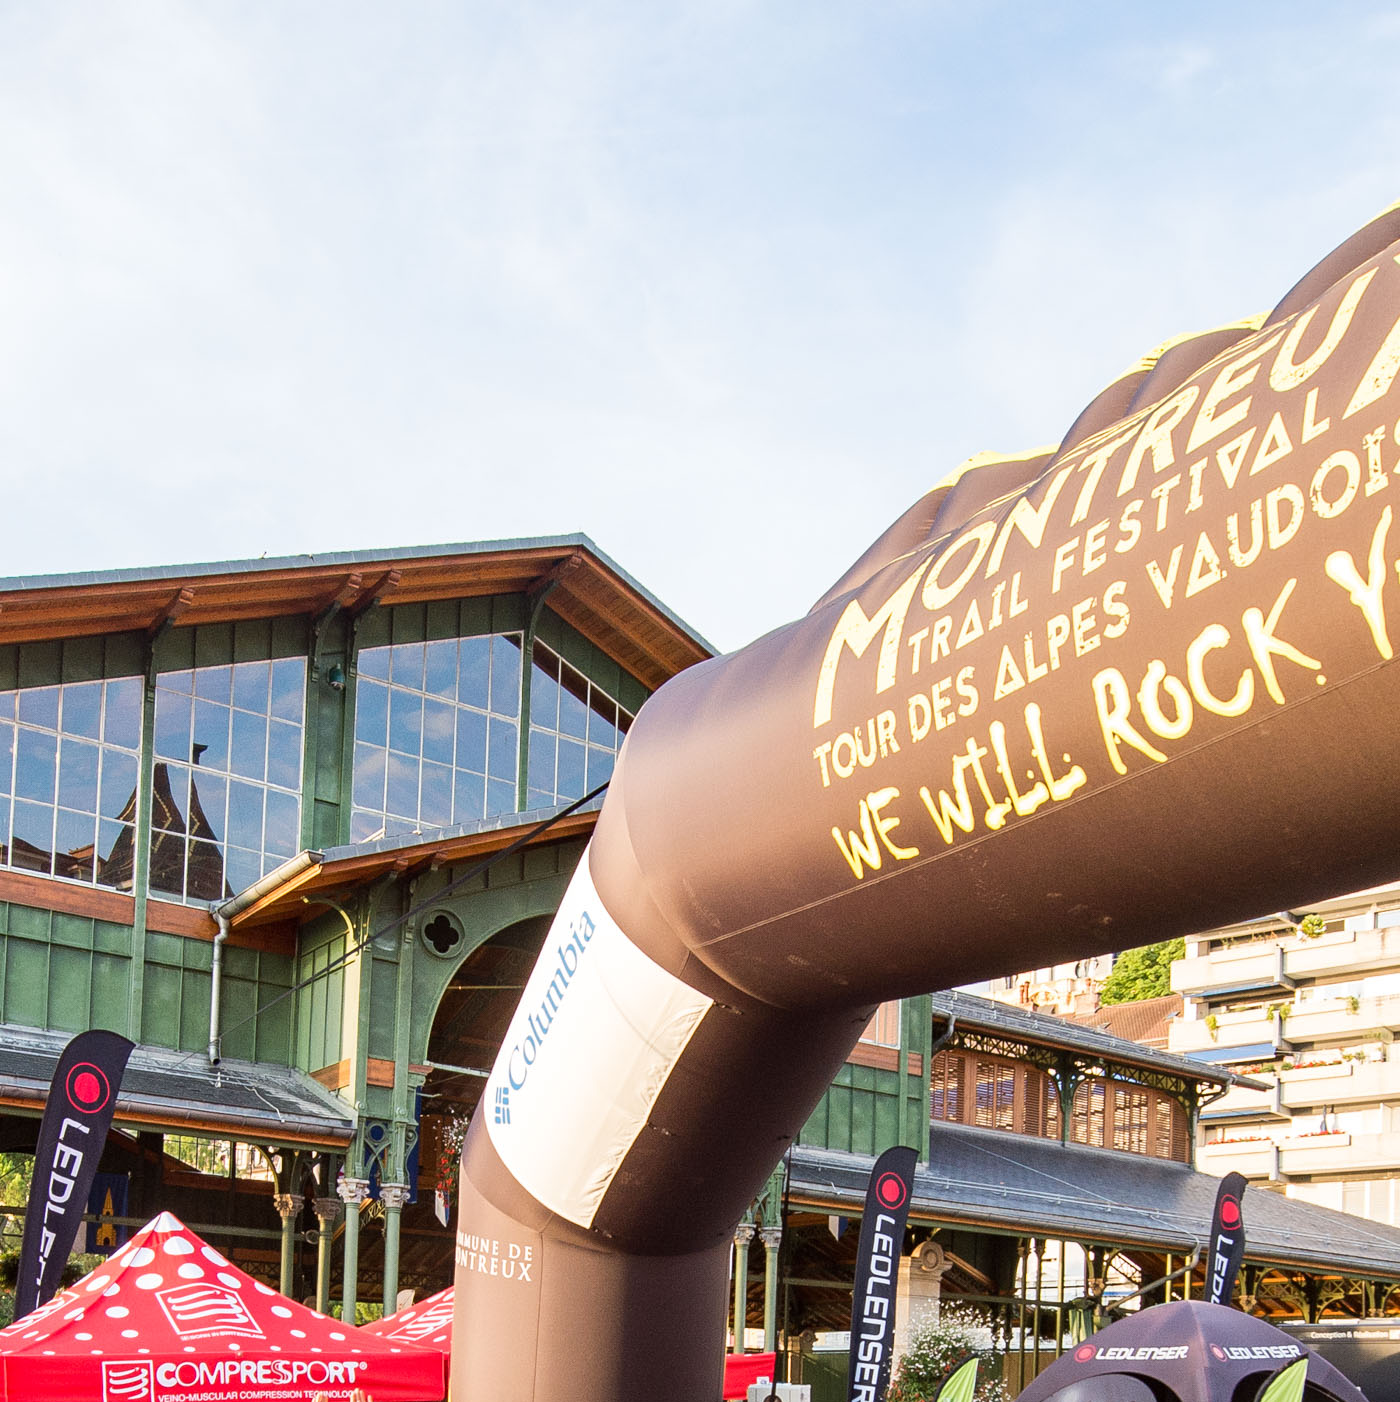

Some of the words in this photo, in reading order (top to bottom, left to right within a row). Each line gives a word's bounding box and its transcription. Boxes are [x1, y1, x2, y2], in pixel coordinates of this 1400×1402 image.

[908, 576, 1028, 676] TRAIL
[1053, 391, 1331, 595] FESTIVAL
[812, 721, 899, 788] TOUR
[910, 669, 979, 743] DES
[994, 581, 1130, 702] ALPES
[832, 786, 919, 879] WE
[920, 703, 1087, 846] WILL
[1091, 578, 1323, 775] ROCK
[504, 908, 597, 1092] Columbia
[508, 1243, 533, 1262] DE
[239, 1390, 302, 1400] COMPRESSION
